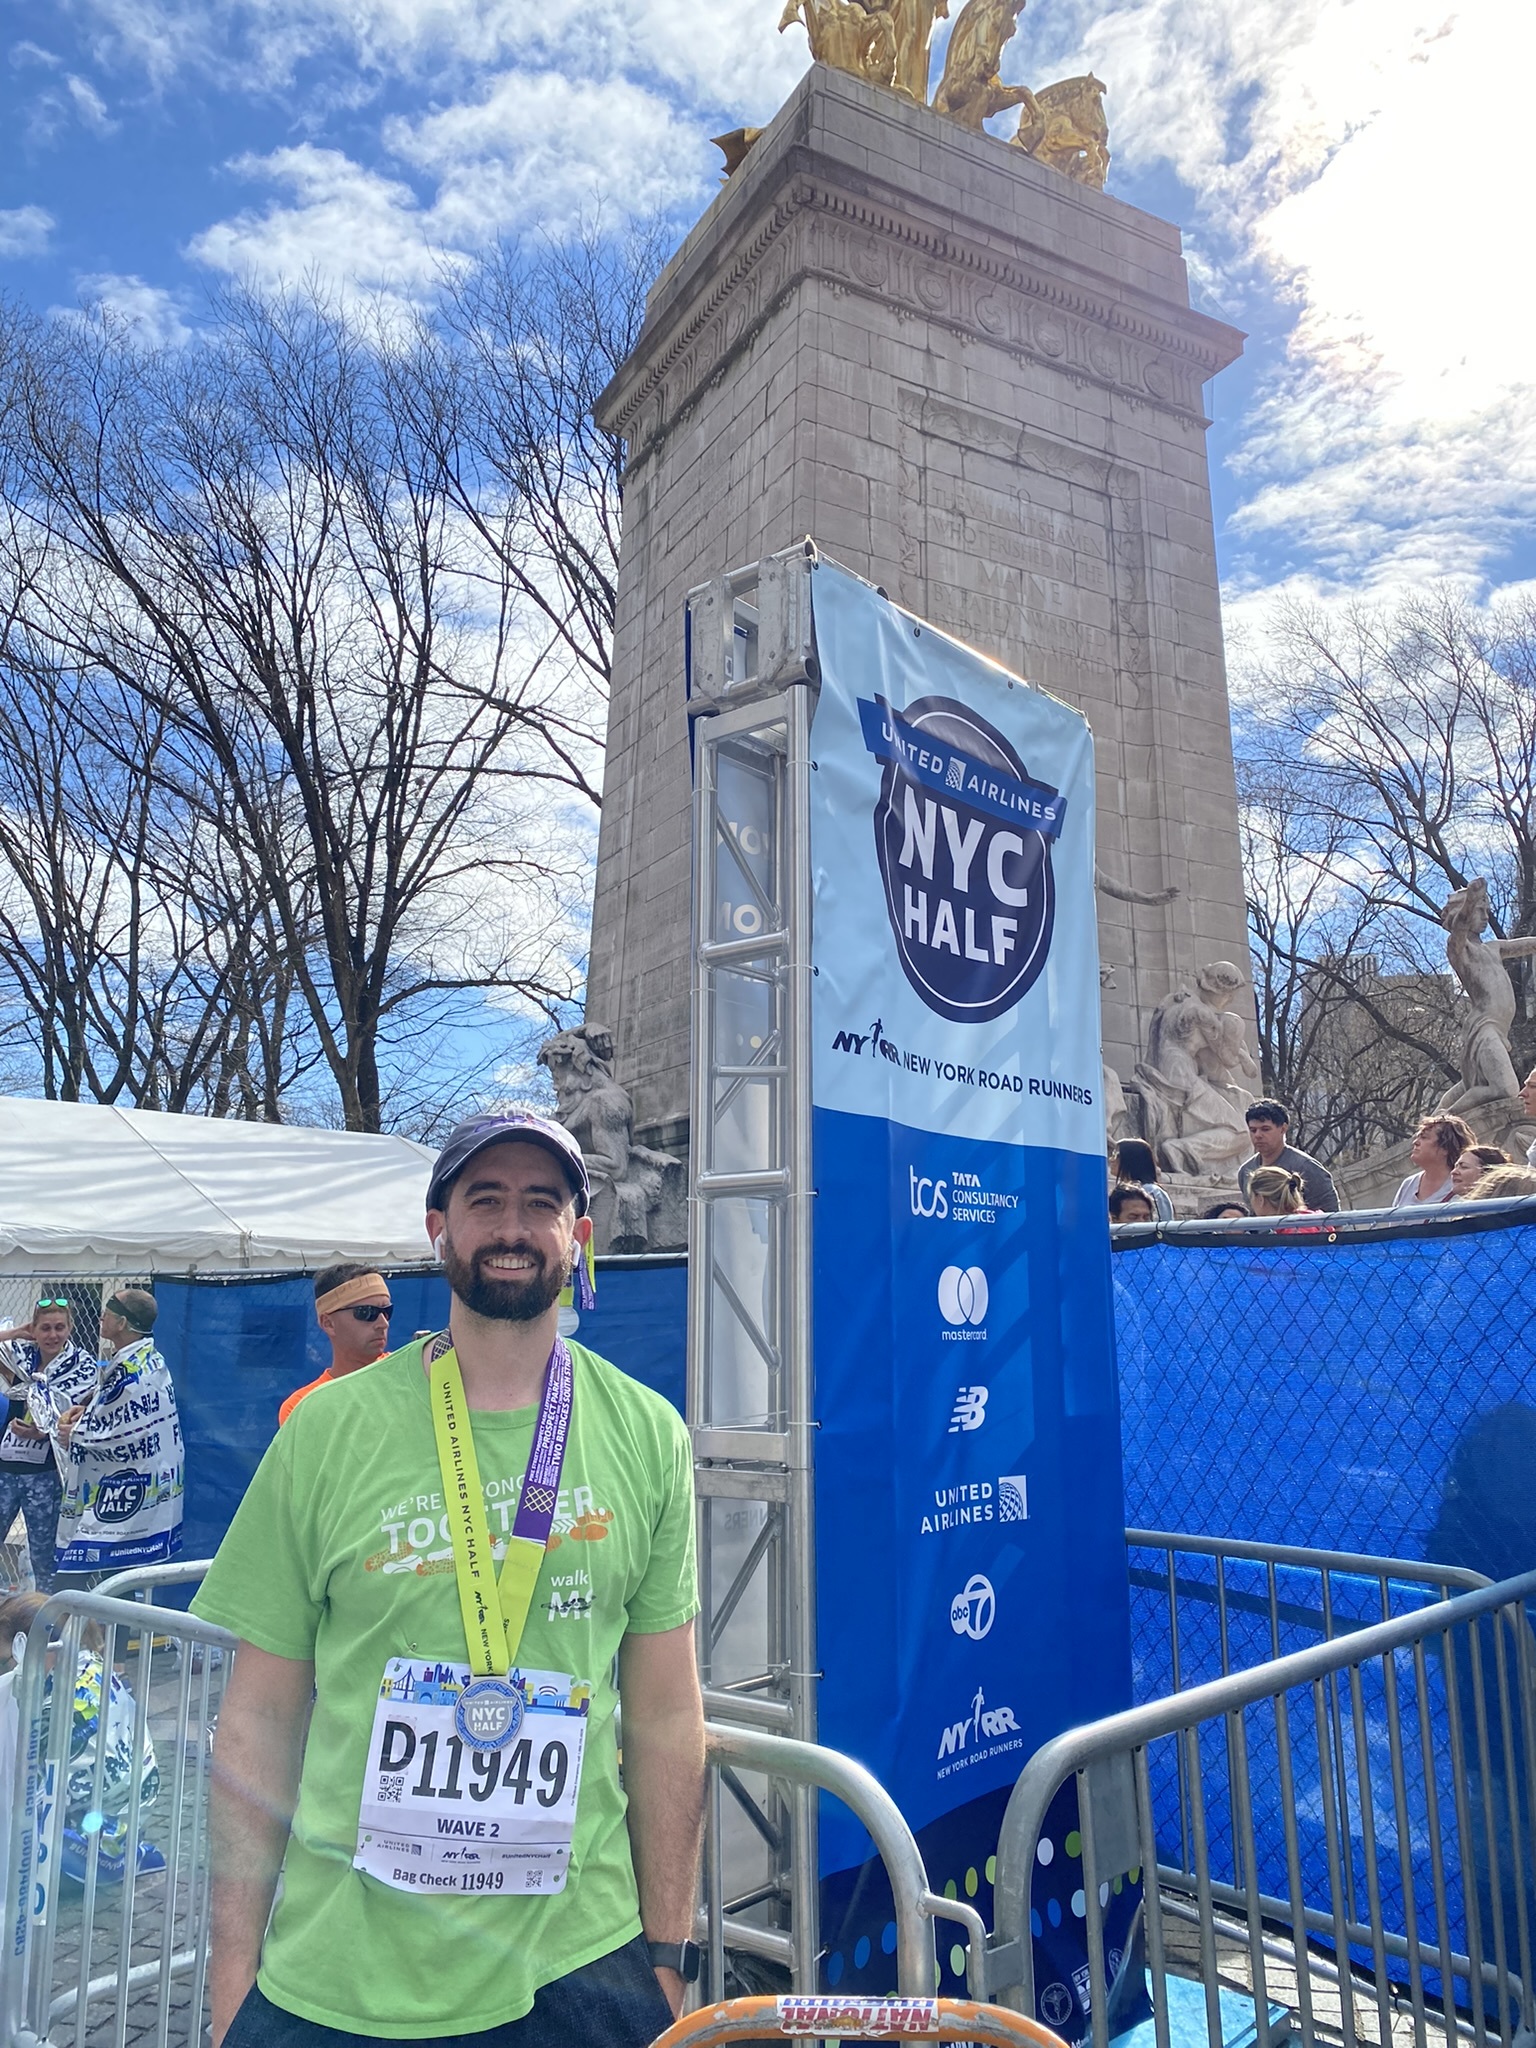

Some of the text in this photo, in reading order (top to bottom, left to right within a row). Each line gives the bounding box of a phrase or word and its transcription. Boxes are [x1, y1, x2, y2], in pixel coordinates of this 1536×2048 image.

[881, 722, 1056, 822] UNITED AIRLINES
[898, 784, 1028, 908] NYC
[903, 890, 1018, 966] HALF
[903, 1048, 932, 1076] NEW
[934, 1056, 976, 1086] YORK
[978, 1067, 1023, 1094] ROAD
[1029, 1077, 1093, 1106] RUNNERS
[909, 1165, 949, 1219] tcs
[952, 1172, 981, 1188] TATA
[952, 1189, 1019, 1209] CONSULTANCY
[952, 1207, 996, 1224] SERVICES
[942, 1328, 988, 1341] mastercard
[563, 1376, 572, 1403] SOUTH
[442, 1381, 456, 1430] UNITED
[541, 1404, 558, 1449] PROSPECT
[550, 1380, 560, 1404] PARK
[556, 1401, 570, 1442] BRIDGES
[551, 1443, 563, 1466] TWO
[450, 1436, 468, 1500] AIRLINES
[103, 1485, 138, 1502] NYC
[935, 1482, 993, 1508] UNITED
[461, 1505, 474, 1534] NYC
[920, 1504, 994, 1534] AIRLINES
[466, 1538, 480, 1578] HALF
[551, 1569, 589, 1587] walk
[952, 1605, 969, 1622] abc
[480, 1628, 489, 1648] NEW
[483, 1650, 493, 1672] YORK
[472, 1707, 505, 1721] NYC
[474, 1721, 503, 1731] HALF
[379, 1720, 569, 1808] D11949
[937, 1738, 1023, 1781] NEW YORK ROAD RUNNERS
[437, 1818, 500, 1838] WAVE 2
[392, 1868, 504, 1890] Bag Check 11949
